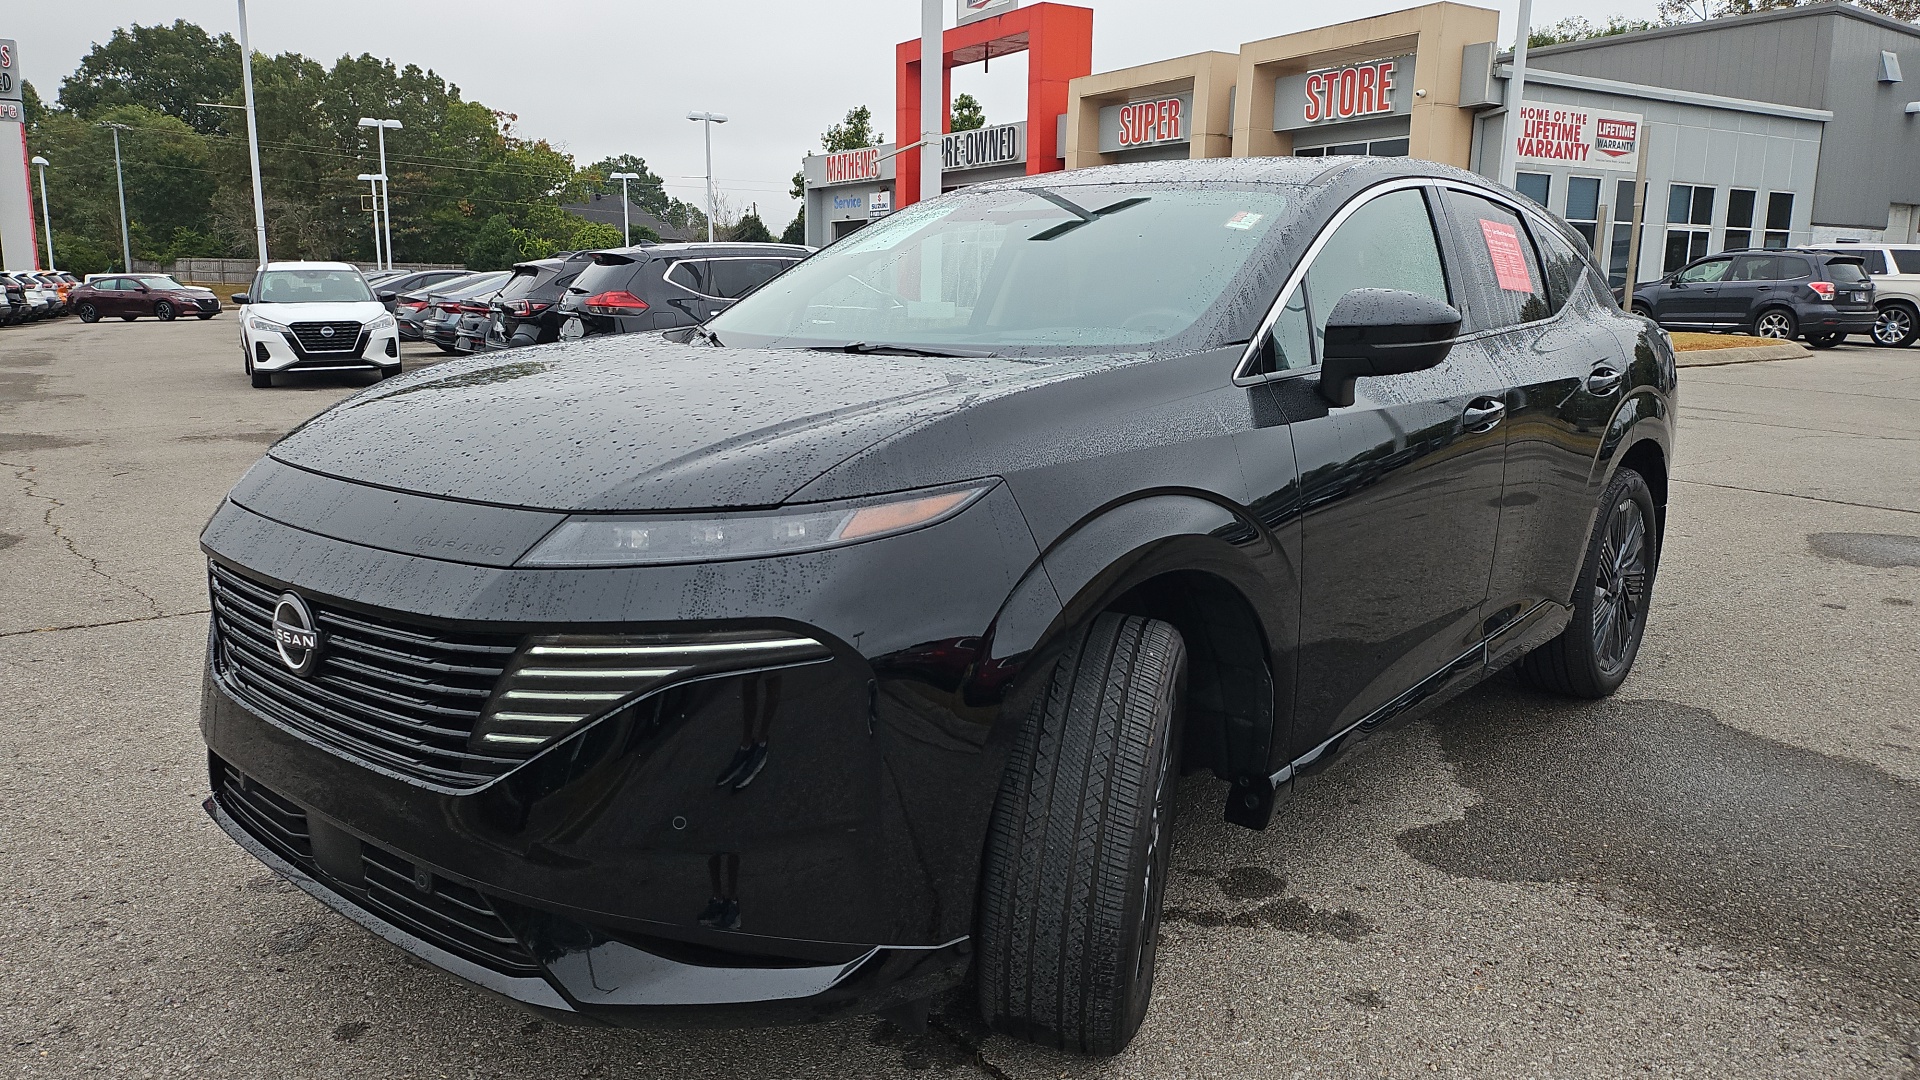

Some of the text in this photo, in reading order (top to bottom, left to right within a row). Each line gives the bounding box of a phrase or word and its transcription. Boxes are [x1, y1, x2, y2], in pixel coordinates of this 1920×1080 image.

[1304, 62, 1395, 122] STORE
[1119, 99, 1181, 146] SUPER
[1520, 107, 1587, 125] HOME OF THE
[1523, 119, 1582, 142] LIFETIME
[1598, 121, 1635, 138] LIFETIME
[1516, 138, 1590, 161] WARRANTY
[1597, 139, 1635, 151] WARRANTY
[826, 149, 879, 183] MATHEWS
[834, 195, 862, 209] Service
[412, 535, 506, 557] MURANO
